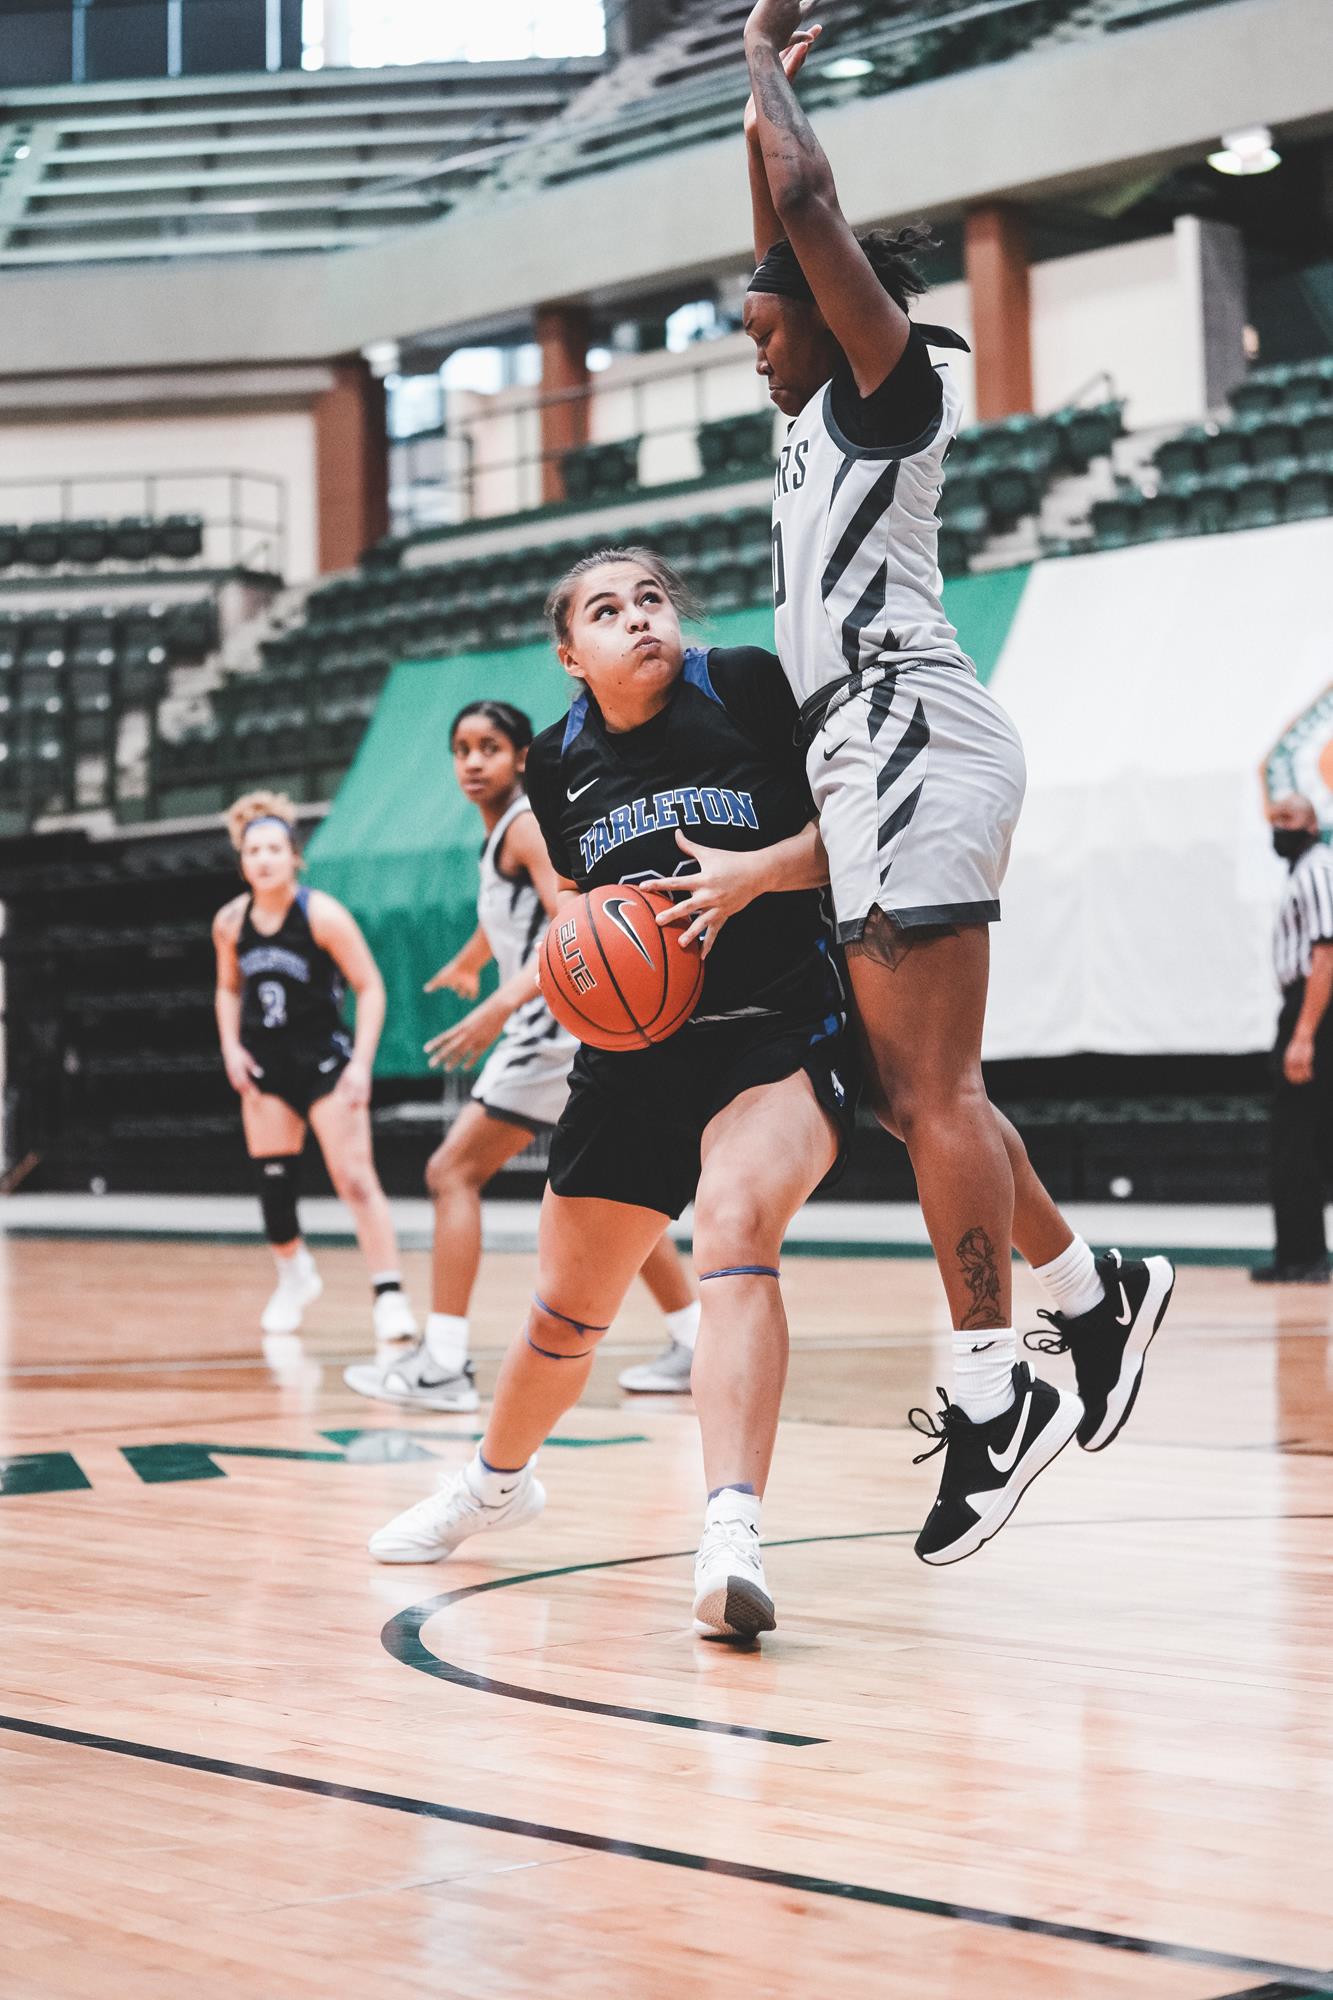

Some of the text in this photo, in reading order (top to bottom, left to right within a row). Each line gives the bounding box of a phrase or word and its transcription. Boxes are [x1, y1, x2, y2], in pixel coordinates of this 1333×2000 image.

[774, 439, 809, 501] RS
[579, 787, 759, 874] TARLETON
[560, 918, 597, 994] ELITE
